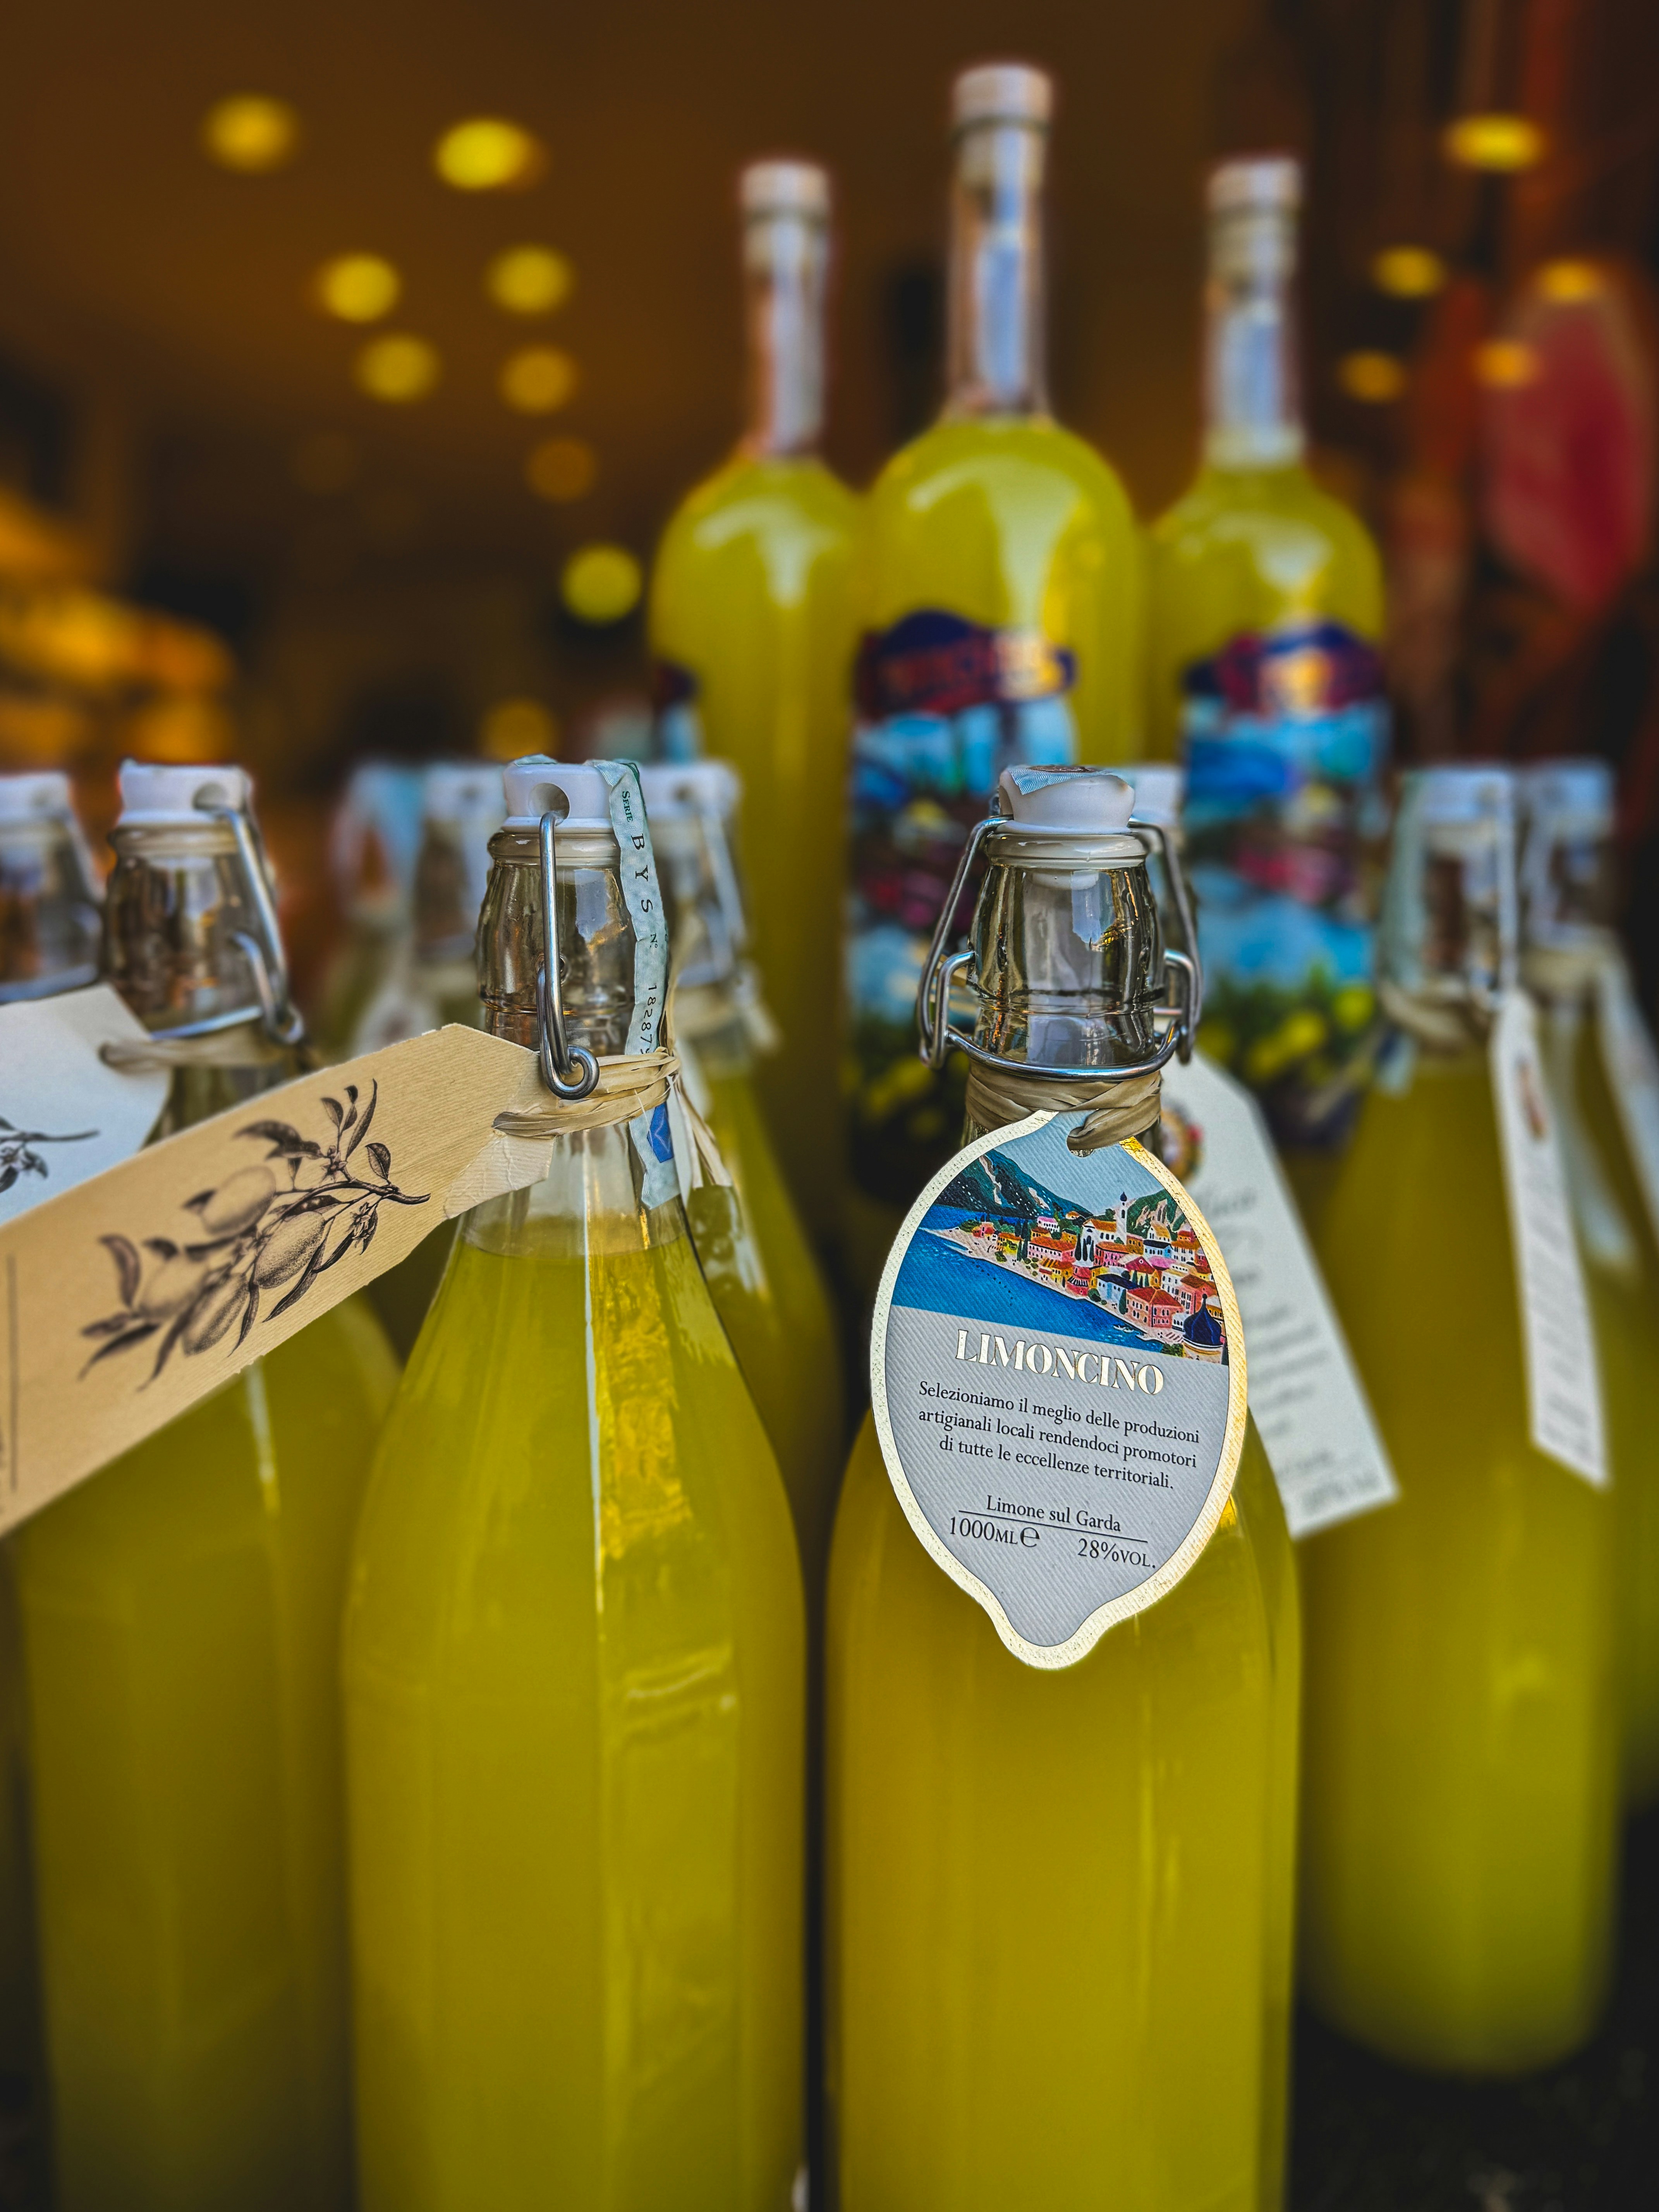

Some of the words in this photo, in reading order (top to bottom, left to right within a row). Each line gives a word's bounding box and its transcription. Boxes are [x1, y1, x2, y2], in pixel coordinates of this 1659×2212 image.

[622, 791, 633, 822] SERIE
[955, 1329, 1164, 1395] LIMONCINO
[919, 1381, 1014, 1410] Selezioniamo
[1018, 1398, 1028, 1413] il
[1032, 1404, 1081, 1425] meglio
[1085, 1409, 1120, 1429] delle
[1124, 1420, 1199, 1443] produzioni
[919, 1410, 991, 1431] artigianali
[996, 1418, 1034, 1439] locali
[1039, 1431, 1119, 1454] rendendoci
[1123, 1445, 1197, 1468] promotori
[939, 1435, 953, 1451] di
[958, 1441, 993, 1458] tutte
[998, 1444, 1011, 1461] le
[1015, 1452, 1089, 1474] eccellenze
[1094, 1463, 1174, 1489] territoriali.
[986, 1494, 1045, 1519] Limone
[1049, 1506, 1070, 1523] sul
[1076, 1510, 1121, 1532] Garda
